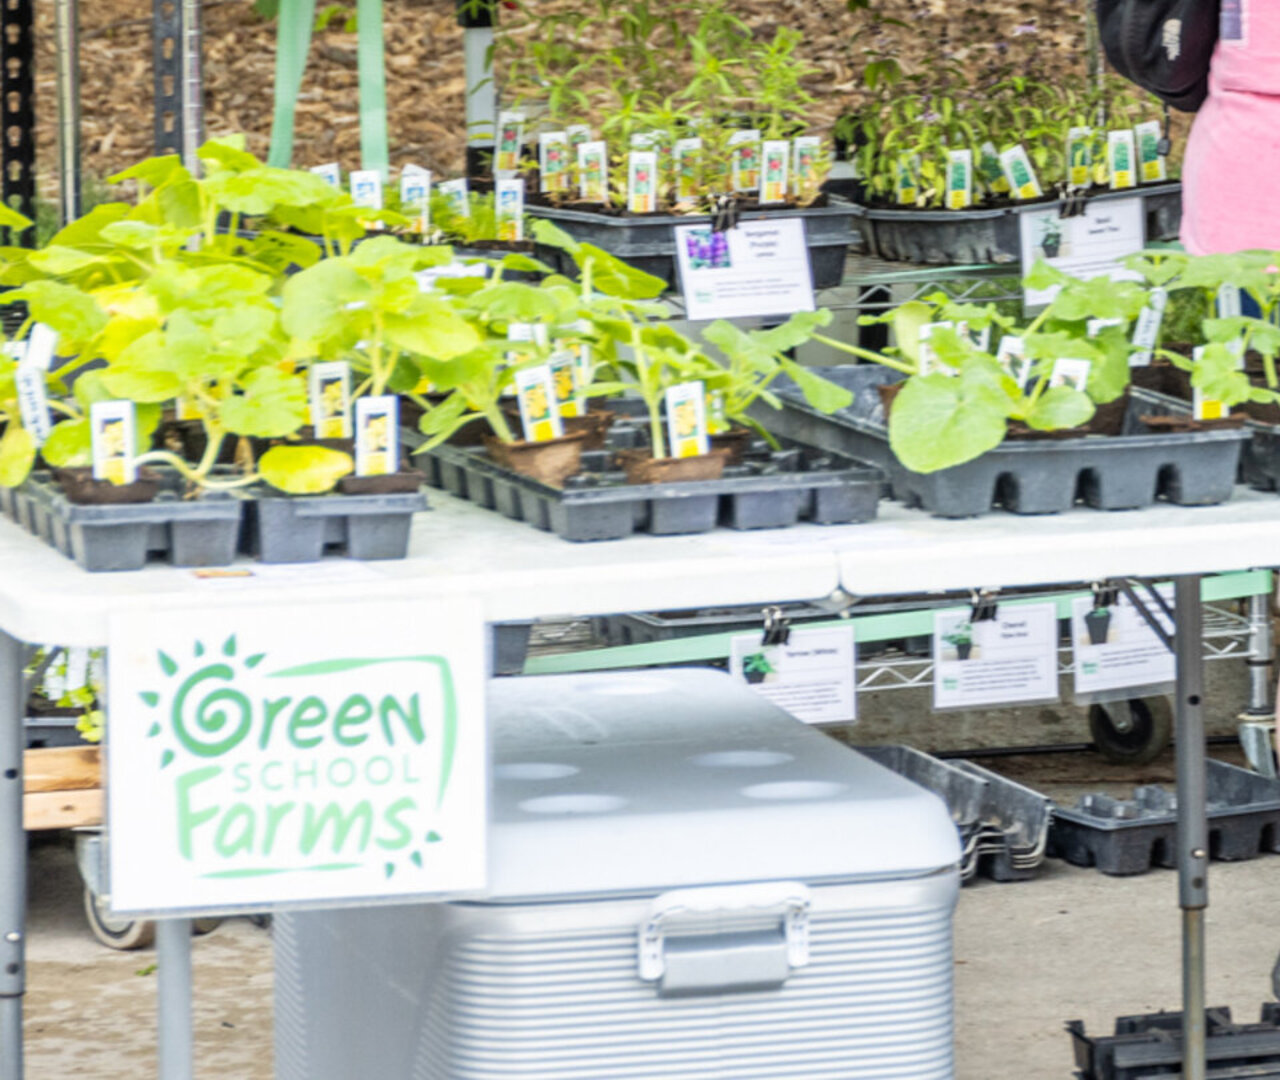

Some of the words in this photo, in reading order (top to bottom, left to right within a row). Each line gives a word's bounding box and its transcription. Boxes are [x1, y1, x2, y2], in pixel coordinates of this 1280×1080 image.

[171, 663, 425, 758] Green
[175, 765, 420, 861] Farms
[232, 754, 421, 793] SCHOOL
